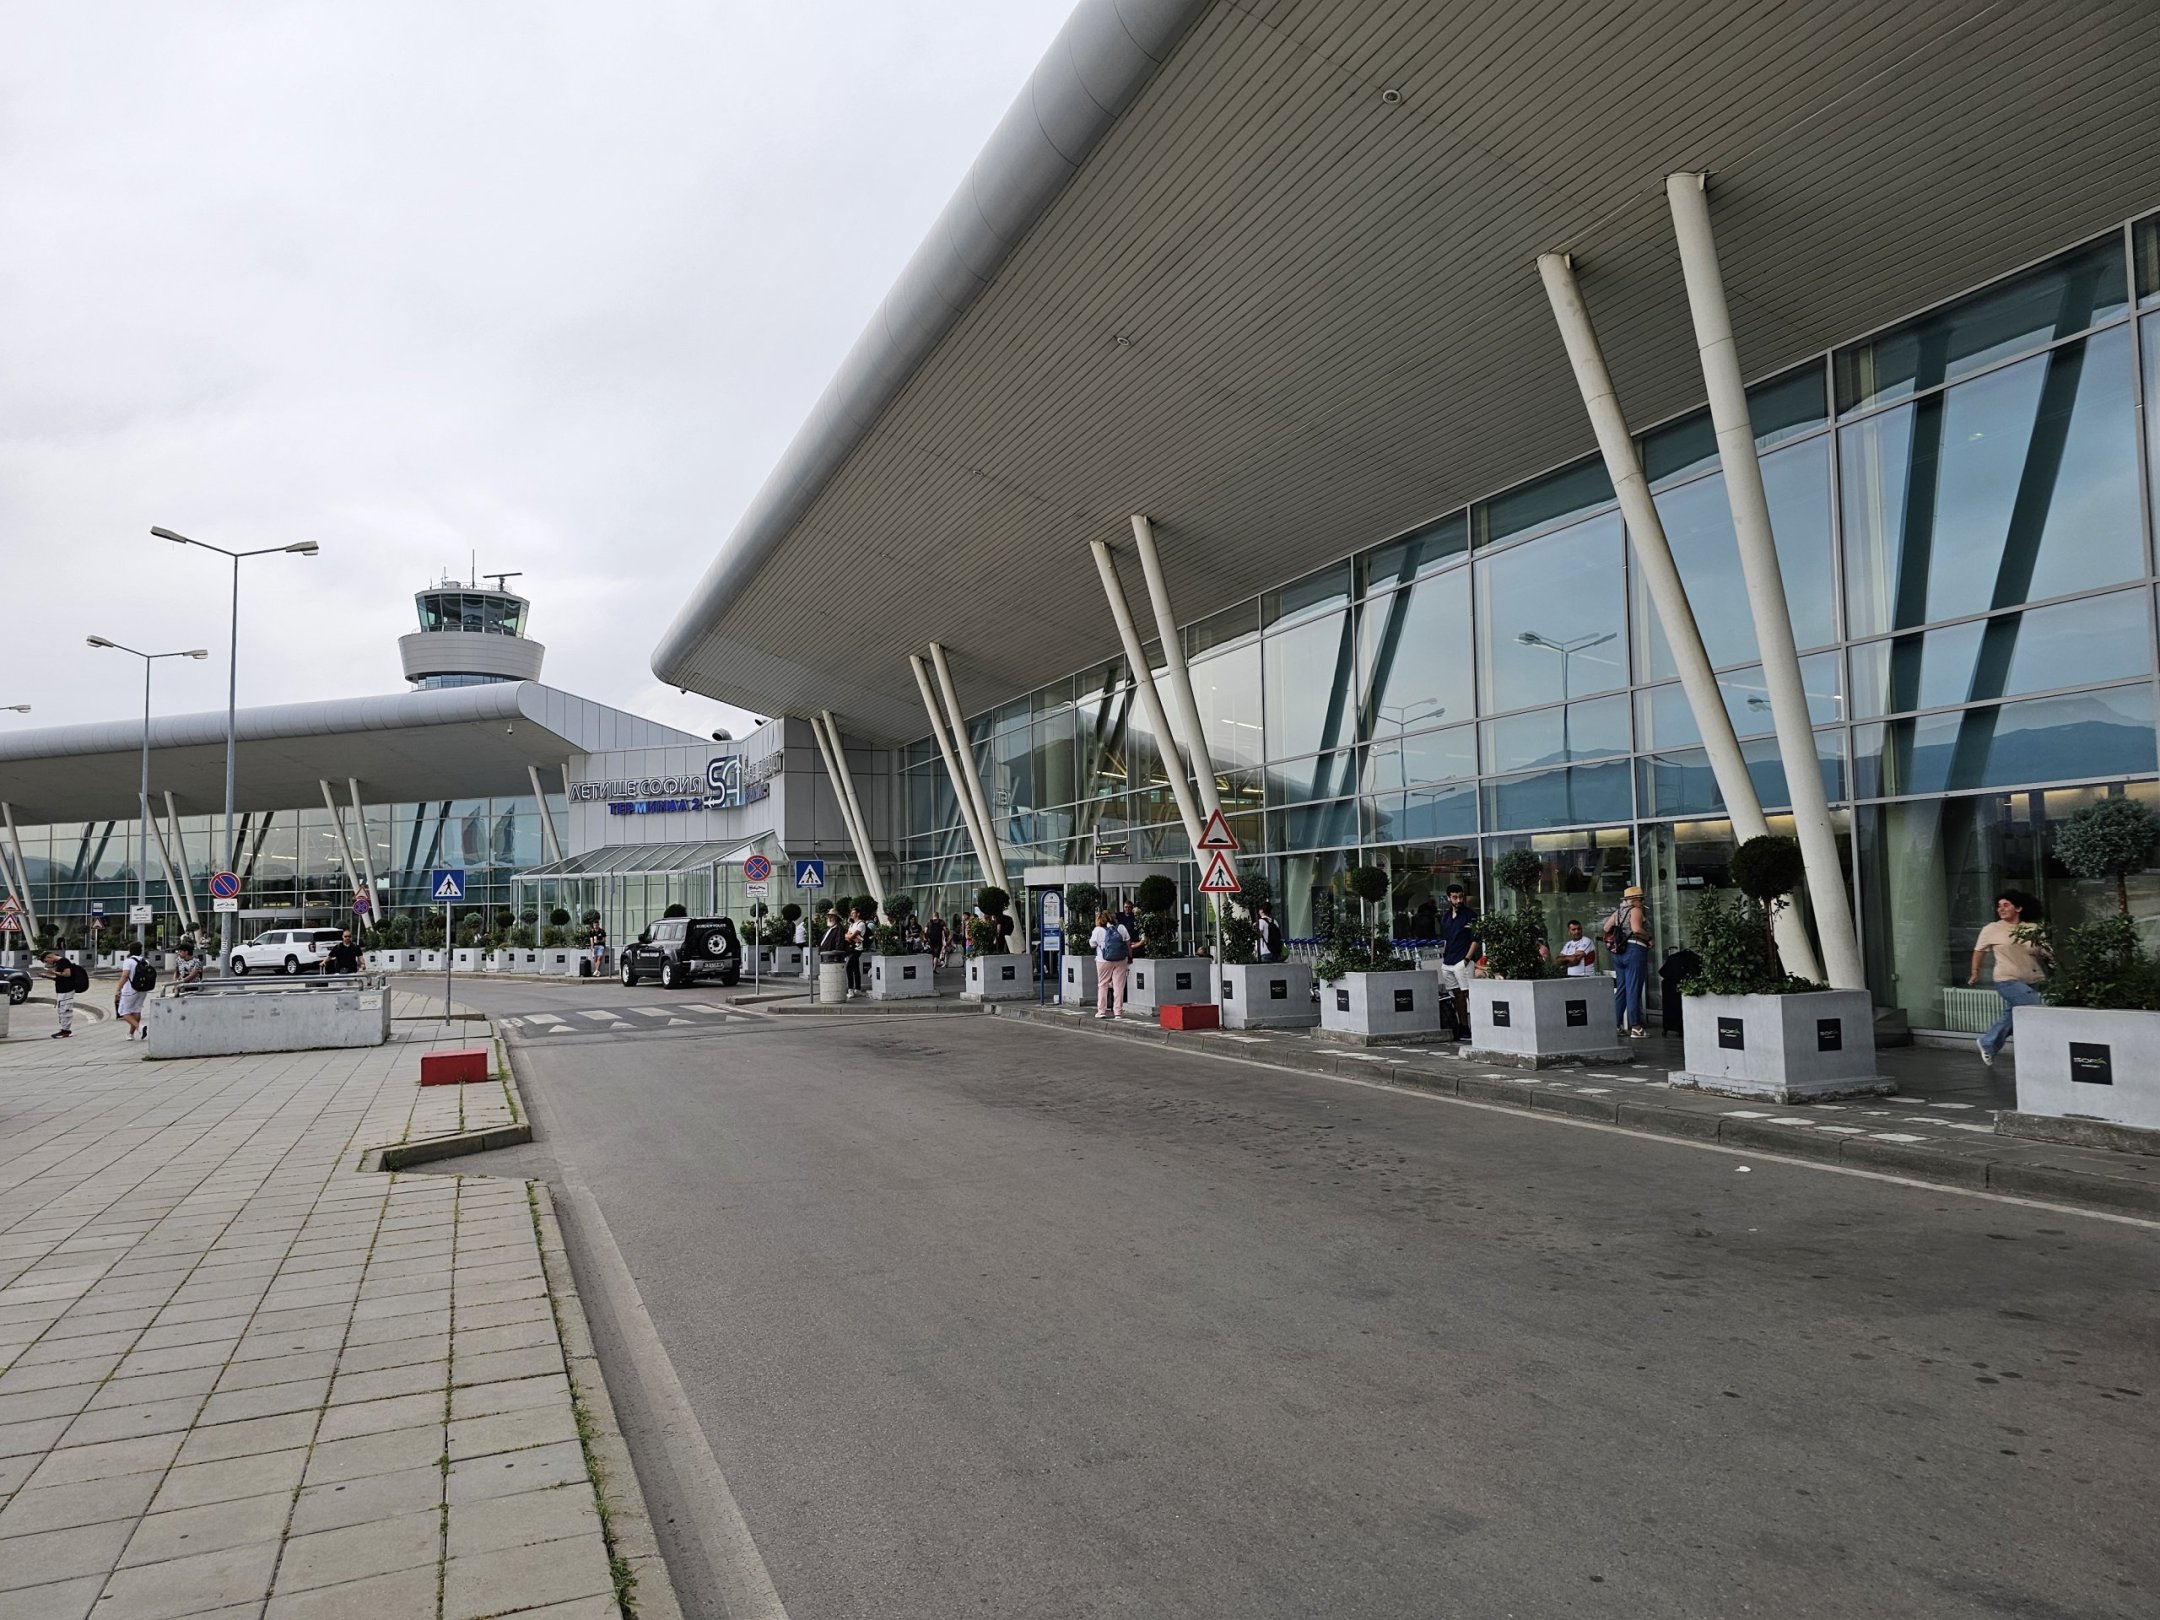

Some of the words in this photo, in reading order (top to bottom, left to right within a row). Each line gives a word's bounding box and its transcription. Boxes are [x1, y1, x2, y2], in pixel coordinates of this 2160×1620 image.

[640, 776, 704, 796] СОФИЯ
[608, 799, 688, 815] ТЕРМИНАЛ
[692, 798, 702, 811] 2
